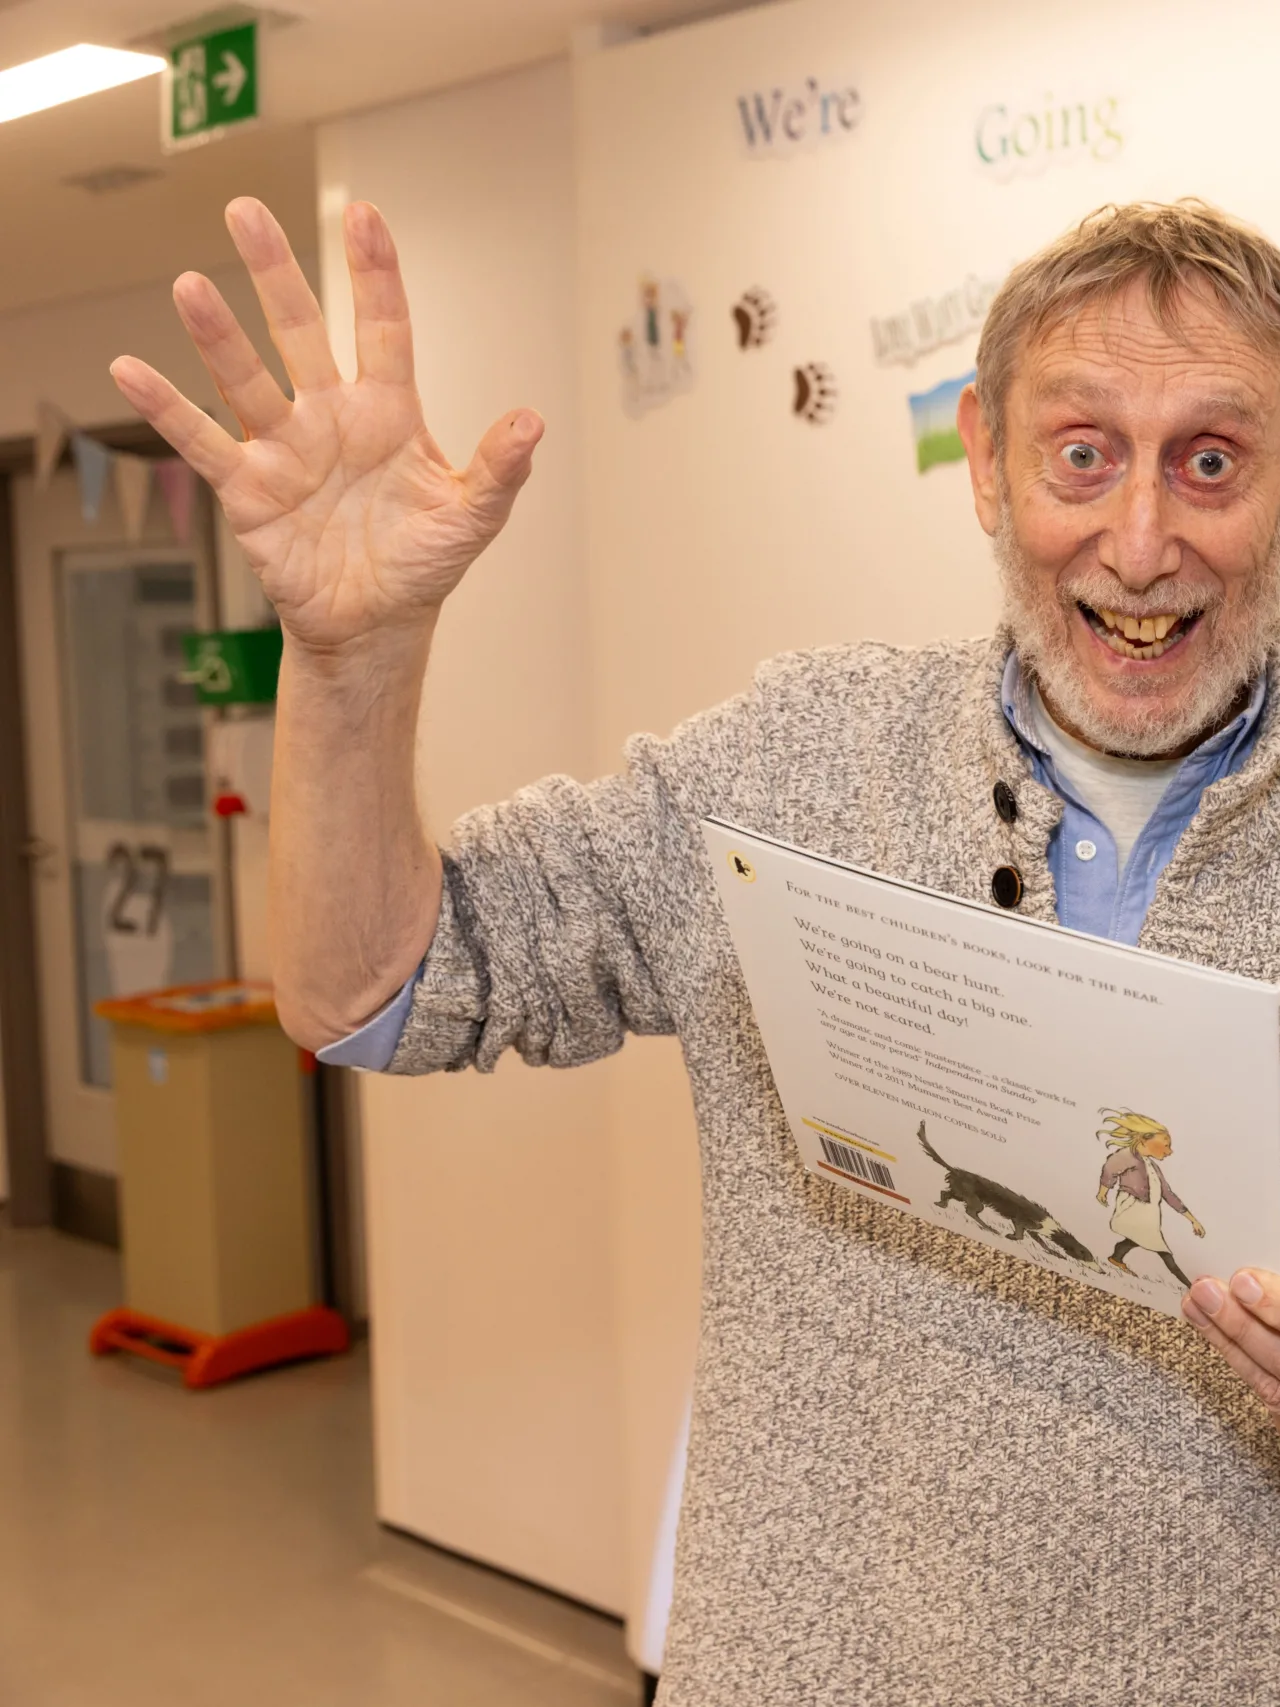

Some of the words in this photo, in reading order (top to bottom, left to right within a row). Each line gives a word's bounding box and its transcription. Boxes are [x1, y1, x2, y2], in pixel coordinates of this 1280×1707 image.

[737, 76, 861, 148] We're
[974, 91, 1125, 162] Going
[793, 916, 836, 941] We're
[840, 936, 882, 959] going
[886, 952, 905, 965] on
[909, 960, 919, 970] a
[923, 961, 958, 982] bear
[963, 975, 1005, 997] hunt.
[799, 938, 841, 963] We're
[845, 958, 886, 981] going
[890, 973, 906, 986] to
[911, 981, 953, 1002] catch
[958, 996, 967, 1006] a
[972, 998, 995, 1017] big
[1000, 1011, 1032, 1027] one.
[815, 893, 841, 908] THE
[845, 904, 876, 920] BEST
[880, 916, 958, 945] CHILDREN'S
[963, 942, 1011, 963] BOOKS,
[1016, 957, 1052, 975] LOOK
[1057, 969, 1084, 983] FOR
[1088, 978, 1118, 993] THE
[1123, 988, 1164, 1005] BEAR.
[805, 959, 848, 985] What
[852, 979, 861, 990] a
[865, 982, 932, 1015] beautiful
[937, 1008, 969, 1027] day!
[810, 980, 852, 1005] We're
[855, 1000, 881, 1016] not
[883, 1010, 936, 1036] scared.
[820, 1020, 836, 1031] any
[840, 1027, 855, 1038] age
[858, 1035, 867, 1043] at
[869, 1039, 886, 1050] any
[925, 1059, 984, 1085] Independent
[986, 1081, 998, 1090] on
[1001, 1086, 1037, 1104] Sunday
[826, 1040, 860, 1059] Winner
[863, 1056, 872, 1064] of
[874, 1060, 889, 1071] the
[892, 1066, 913, 1079] 1989
[945, 1086, 987, 1107] Smarties
[990, 1099, 1014, 1117] Book
[1016, 1111, 1041, 1126] Prize
[829, 1051, 862, 1070] Winner
[865, 1067, 875, 1075] of
[885, 1074, 904, 1086] 2011
[907, 1082, 951, 1104] Mumsnet
[953, 1099, 974, 1112] Best
[976, 1108, 1008, 1124] Award
[830, 1014, 872, 1035] dramatic
[874, 1031, 892, 1043] and
[894, 1039, 921, 1053] comic
[924, 1050, 982, 1075] masterpiece
[1001, 1076, 1032, 1093] classic
[1034, 1089, 1061, 1102] work
[1062, 1097, 1077, 1107] for
[834, 1072, 861, 1088] OVER
[862, 1084, 900, 1103] ELEVEN
[901, 1099, 942, 1119] MILLION
[944, 1115, 979, 1133] COPIES
[981, 1128, 1007, 1143] SOLD
